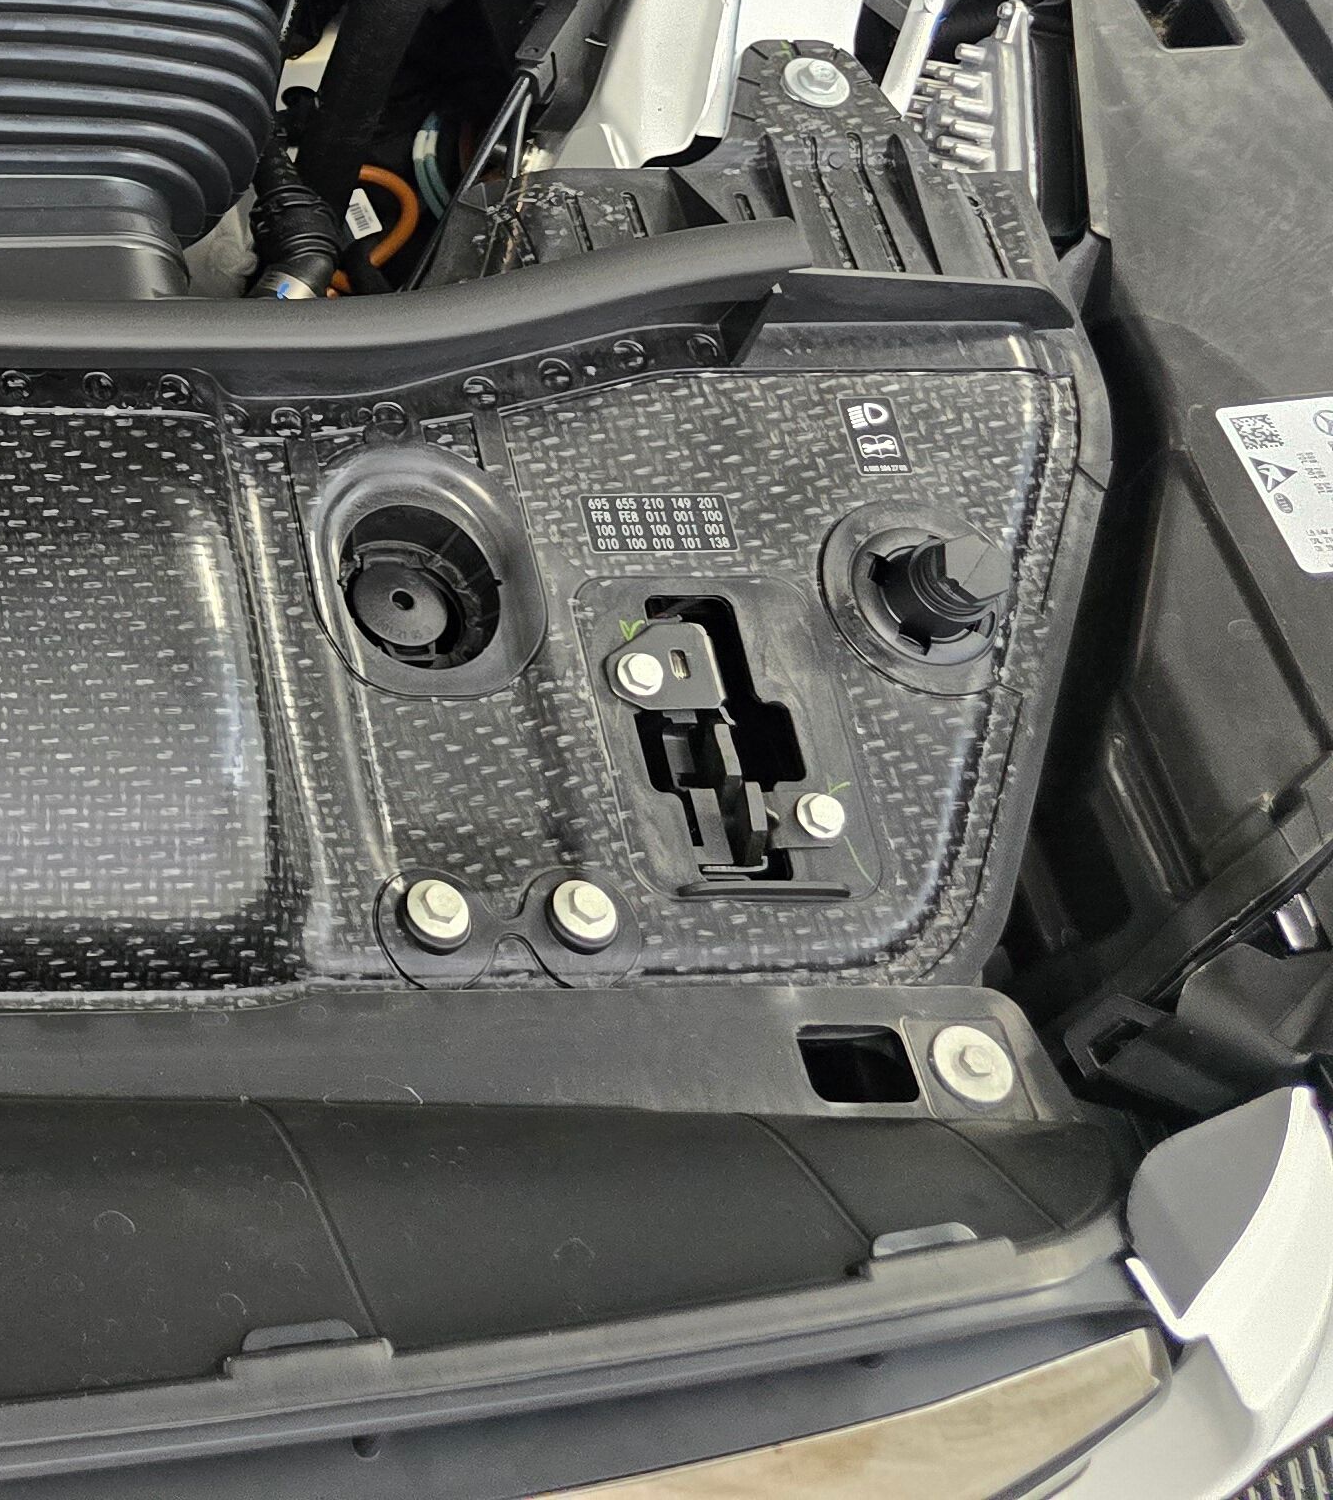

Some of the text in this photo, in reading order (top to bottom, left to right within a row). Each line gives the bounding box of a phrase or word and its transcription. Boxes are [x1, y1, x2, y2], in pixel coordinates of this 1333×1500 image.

[588, 497, 718, 509] 695 655 210 149 201
[591, 511, 723, 523] FF8 FE8 011 001 100
[596, 524, 725, 536] 100 010 100 011 001
[598, 537, 730, 550] 010 100 010 101 138
